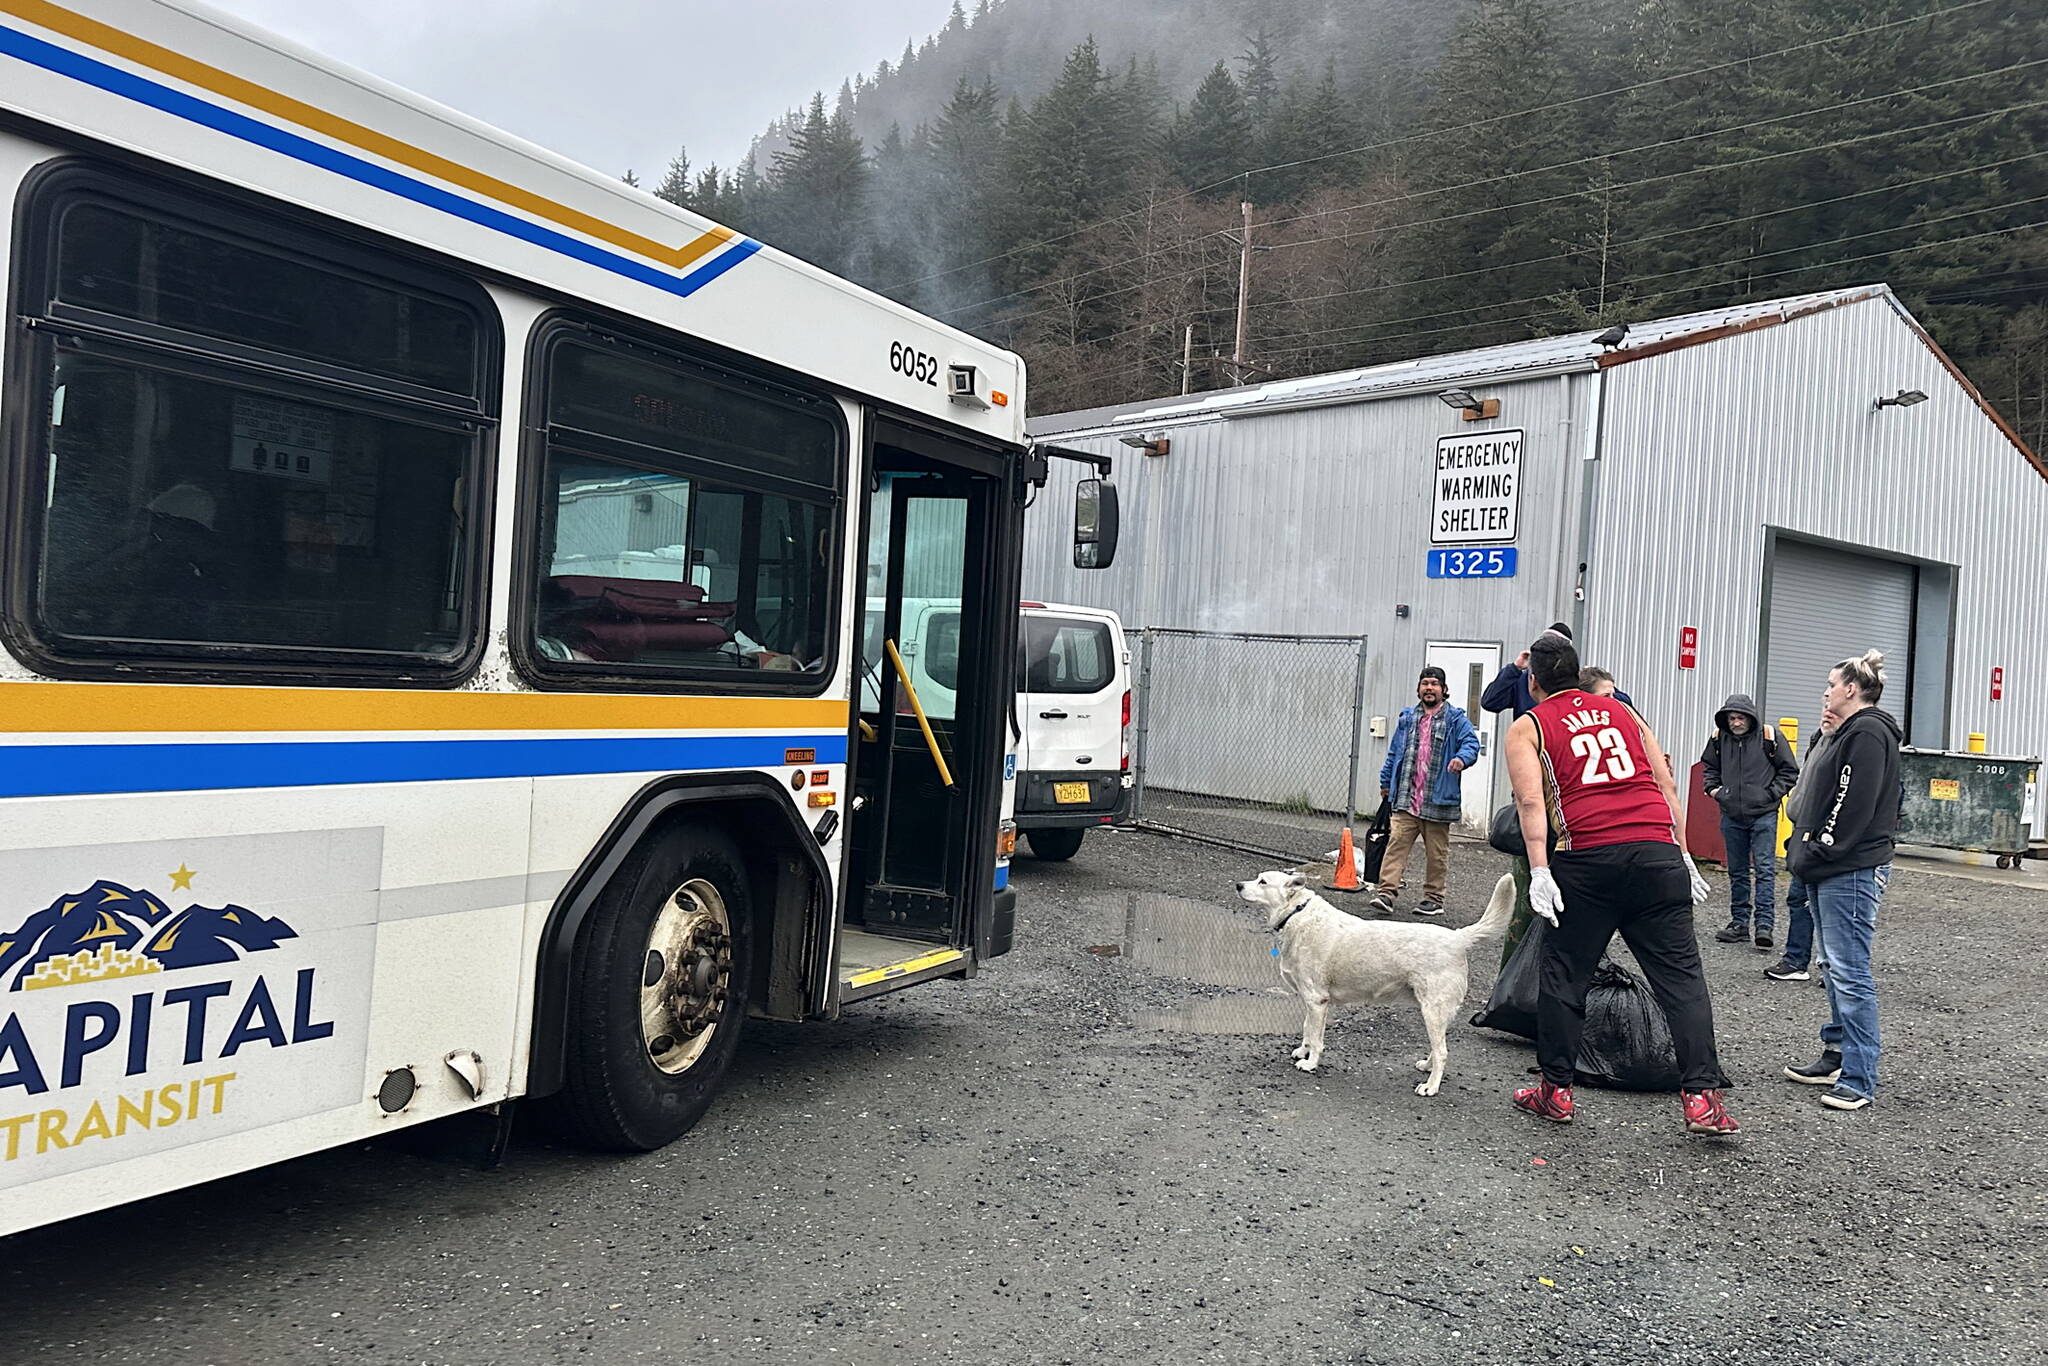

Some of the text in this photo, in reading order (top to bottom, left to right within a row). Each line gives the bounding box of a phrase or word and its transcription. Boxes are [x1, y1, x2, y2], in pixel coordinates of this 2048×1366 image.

[890, 341, 938, 387] 6052
[1438, 441, 1519, 470] EMERGENCY
[1442, 474, 1512, 501] WARMING
[1440, 507, 1509, 532] SHELTER
[1439, 551, 1504, 575] 1325
[1685, 633, 1694, 645] NO
[1561, 709, 1611, 733] JAMES
[786, 751, 814, 761] KNEELING
[1570, 727, 1636, 785] 23
[812, 774, 828, 783] RAMP
[1976, 764, 2005, 775] 2008
[0, 1072, 237, 1161] TRANSIT
